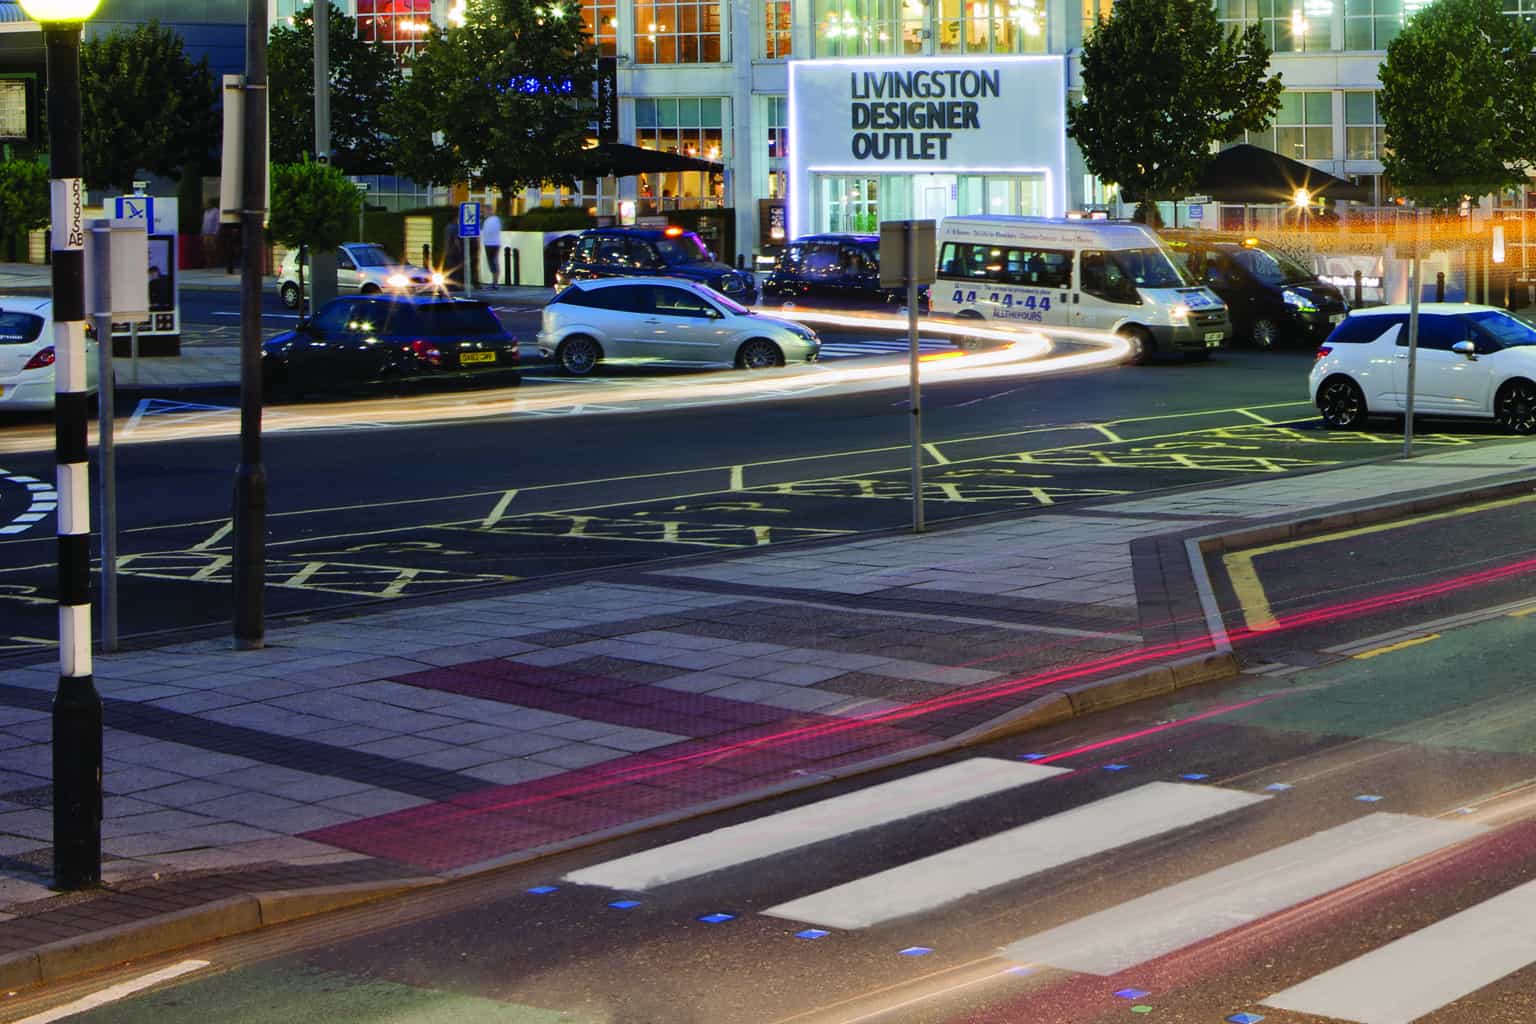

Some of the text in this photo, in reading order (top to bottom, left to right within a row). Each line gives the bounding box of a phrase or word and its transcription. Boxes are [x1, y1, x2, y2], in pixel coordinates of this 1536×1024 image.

[851, 69, 1000, 99] LIVINGSTON
[851, 101, 981, 130] DESIGNER
[851, 132, 953, 161] OUTLET
